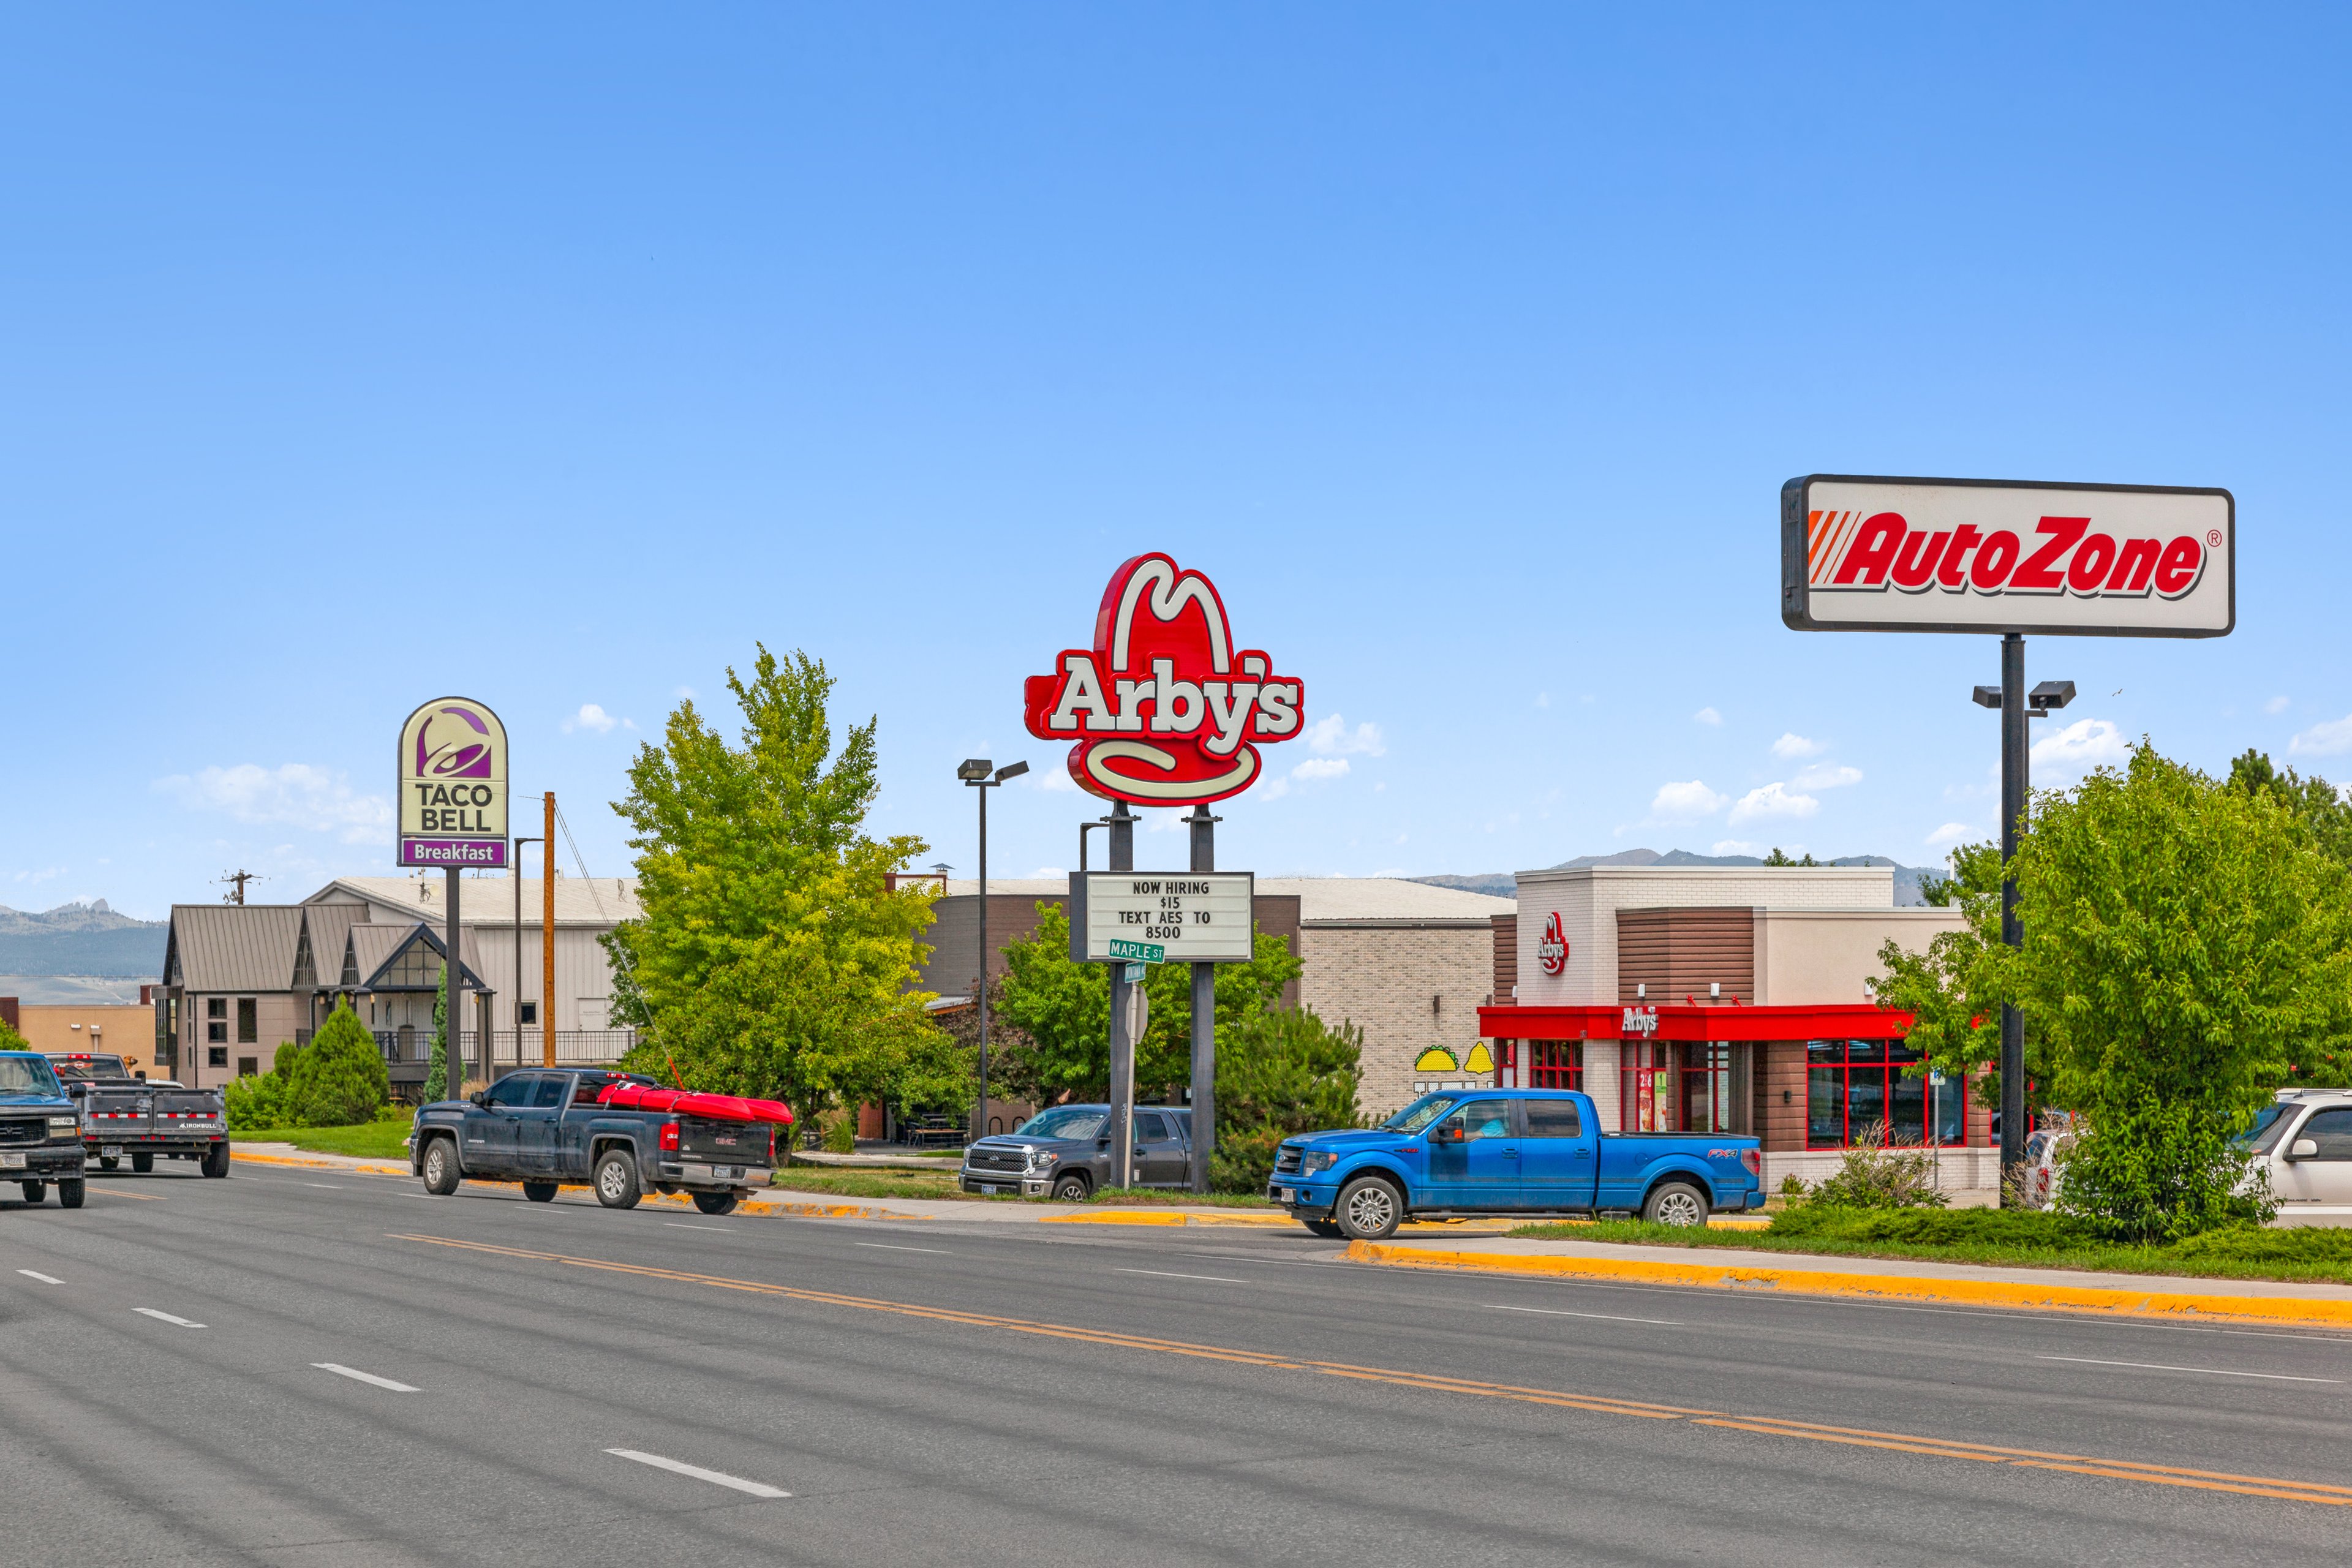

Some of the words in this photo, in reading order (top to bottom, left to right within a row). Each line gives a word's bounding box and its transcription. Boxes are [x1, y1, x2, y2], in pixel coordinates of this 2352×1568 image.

[1833, 511, 2207, 601] AutoZone
[1049, 657, 1298, 754] Arby's
[415, 784, 492, 807] TACO
[421, 809, 491, 832] BELL
[415, 844, 493, 861] Breakfast
[1133, 881, 1161, 894] NOW
[1166, 881, 1210, 894] HIRING
[1161, 897, 1180, 909] $15
[1119, 911, 1151, 924] TEXT
[1159, 911, 1183, 924] AES
[1194, 911, 1211, 924] TO
[1145, 927, 1181, 939] 8500
[1110, 942, 1151, 959] MAPLE
[1153, 949, 1163, 958] ST
[1538, 937, 1564, 963] Arby's
[1622, 1006, 1659, 1038] Arby's
[1640, 1074, 1645, 1088] 2
[1647, 1074, 1652, 1088] 6
[1708, 1149, 1738, 1158] FX4
